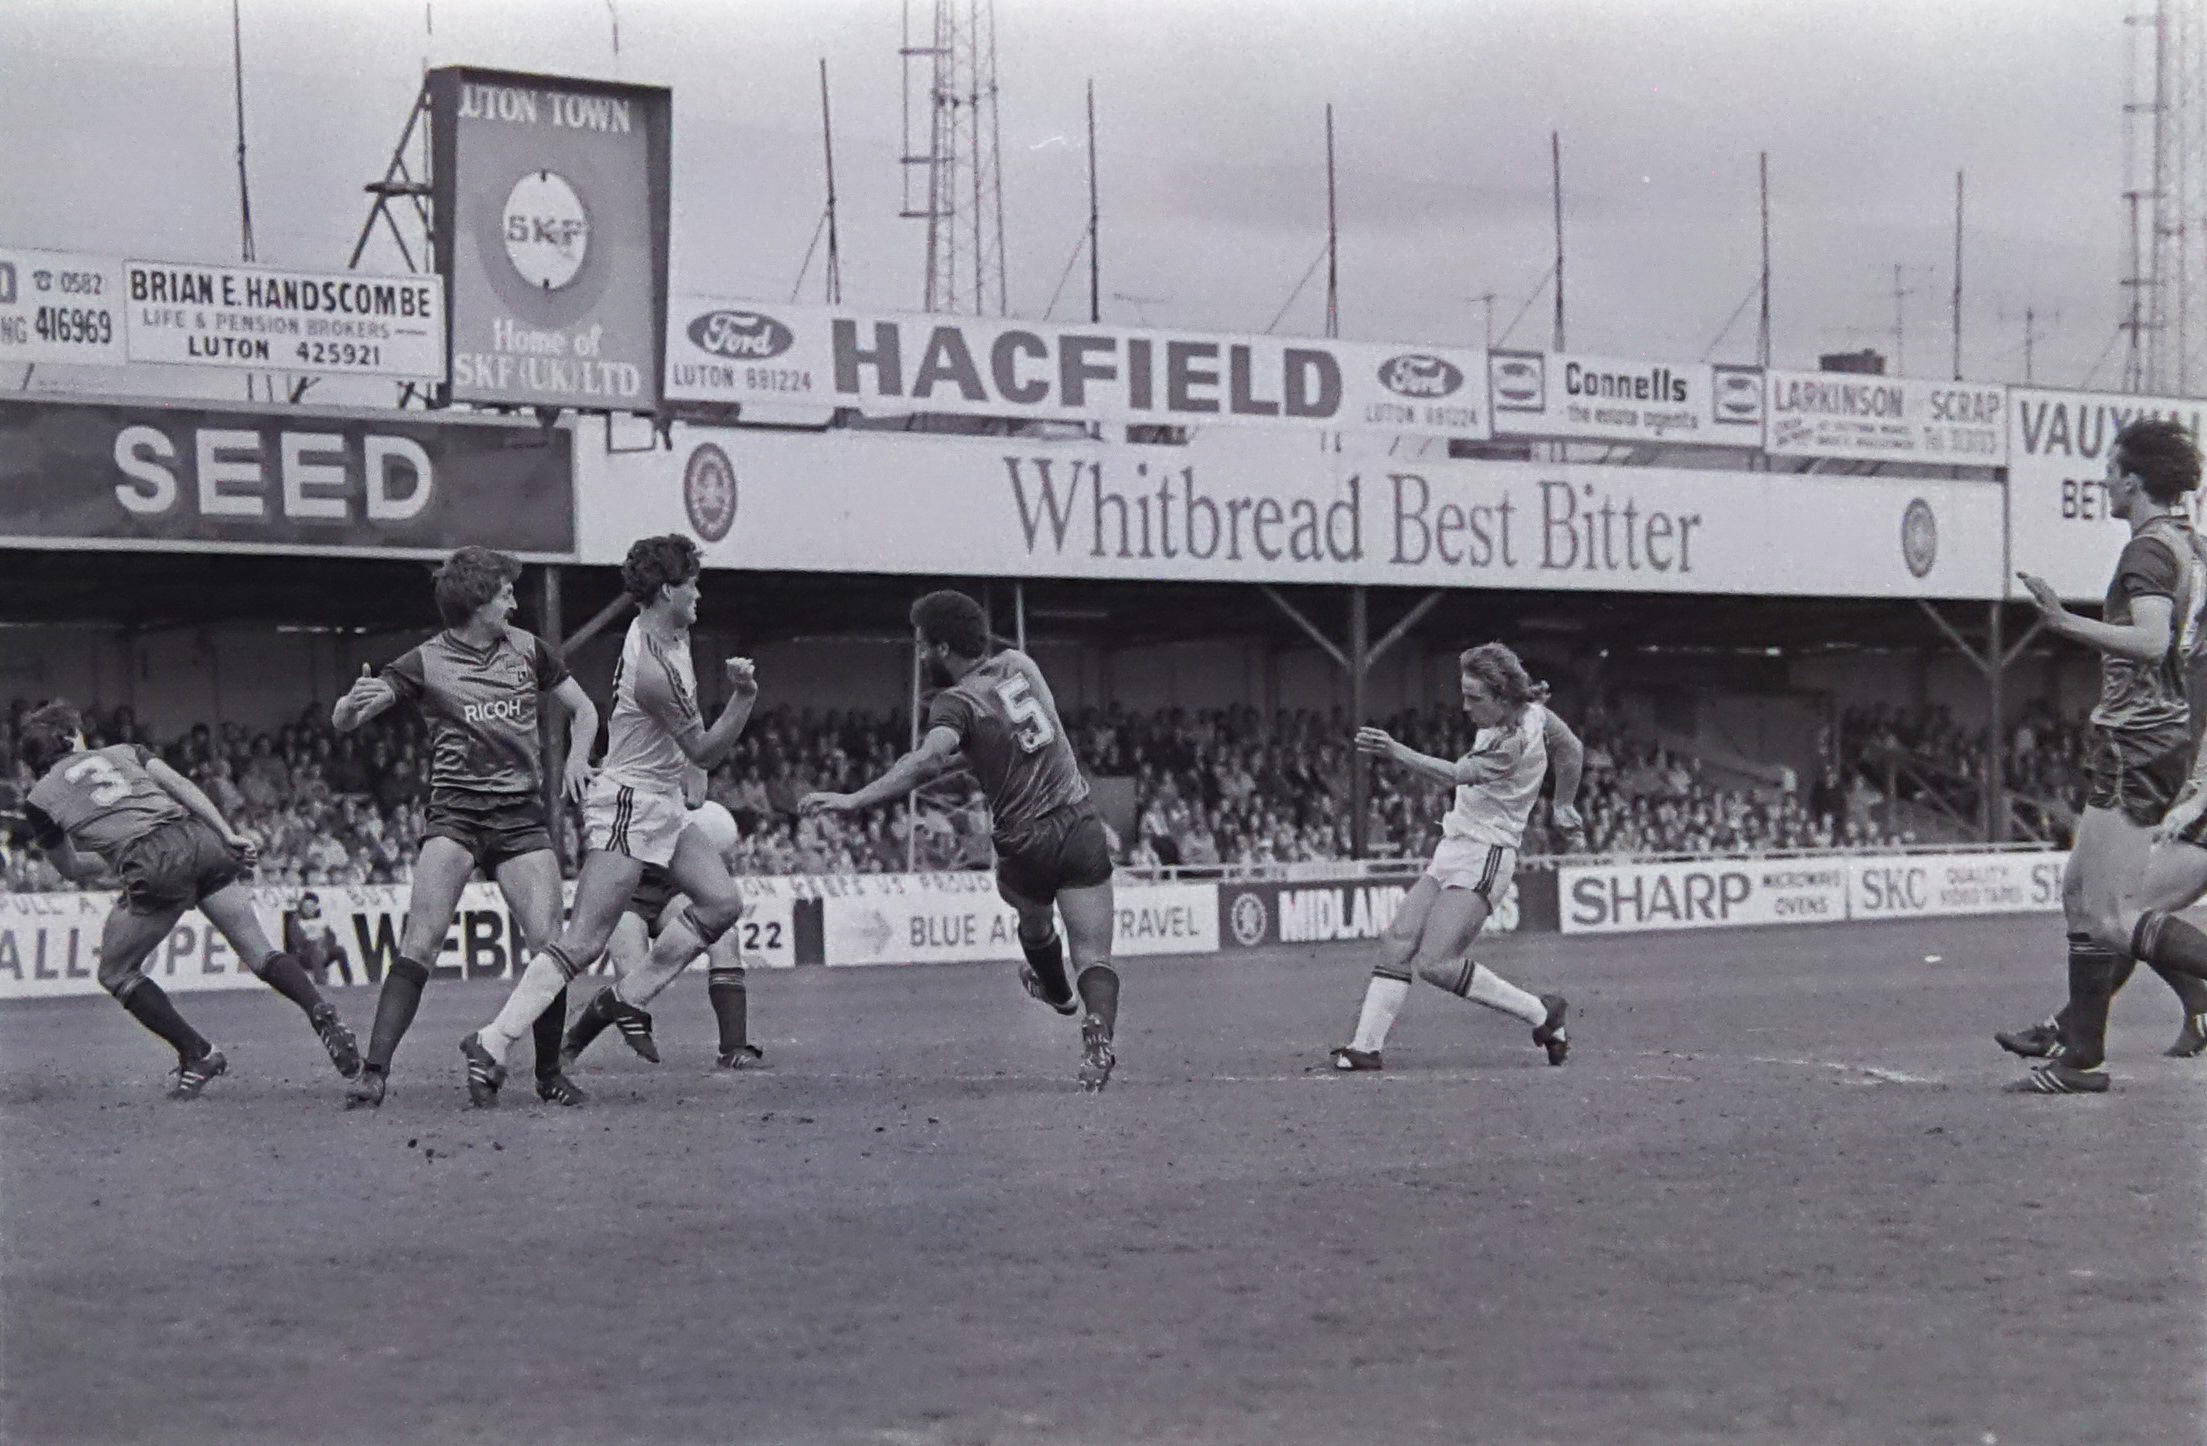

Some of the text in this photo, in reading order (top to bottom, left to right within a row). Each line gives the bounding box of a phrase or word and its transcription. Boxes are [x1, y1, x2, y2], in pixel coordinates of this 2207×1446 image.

[547, 93, 632, 134] TOWN
[506, 215, 582, 246] SKF
[131, 269, 214, 304] BRIAN
[36, 306, 112, 344] 416969
[143, 307, 185, 329] LIFE
[215, 313, 299, 335] PENSION
[306, 319, 391, 340] BROKERS
[493, 318, 603, 356] Home of
[701, 313, 776, 356] Ford
[188, 335, 381, 366] LUTON 425921
[831, 319, 1342, 418] HACFIELD
[453, 352, 513, 389] SKF
[673, 362, 734, 388] LUTON
[1388, 359, 1448, 394] Ford
[1566, 361, 1688, 403] Connells
[1774, 375, 2001, 424] LARKINSON SCRAP
[114, 425, 432, 520] SEED
[1003, 455, 1703, 574] Whitbread Best Bitter
[464, 699, 522, 723] RICOH
[996, 671, 1055, 754] 5
[64, 755, 133, 807] 3
[1571, 871, 1752, 926] SHARP
[1861, 868, 1927, 910] SKC
[910, 914, 977, 949] BLUE
